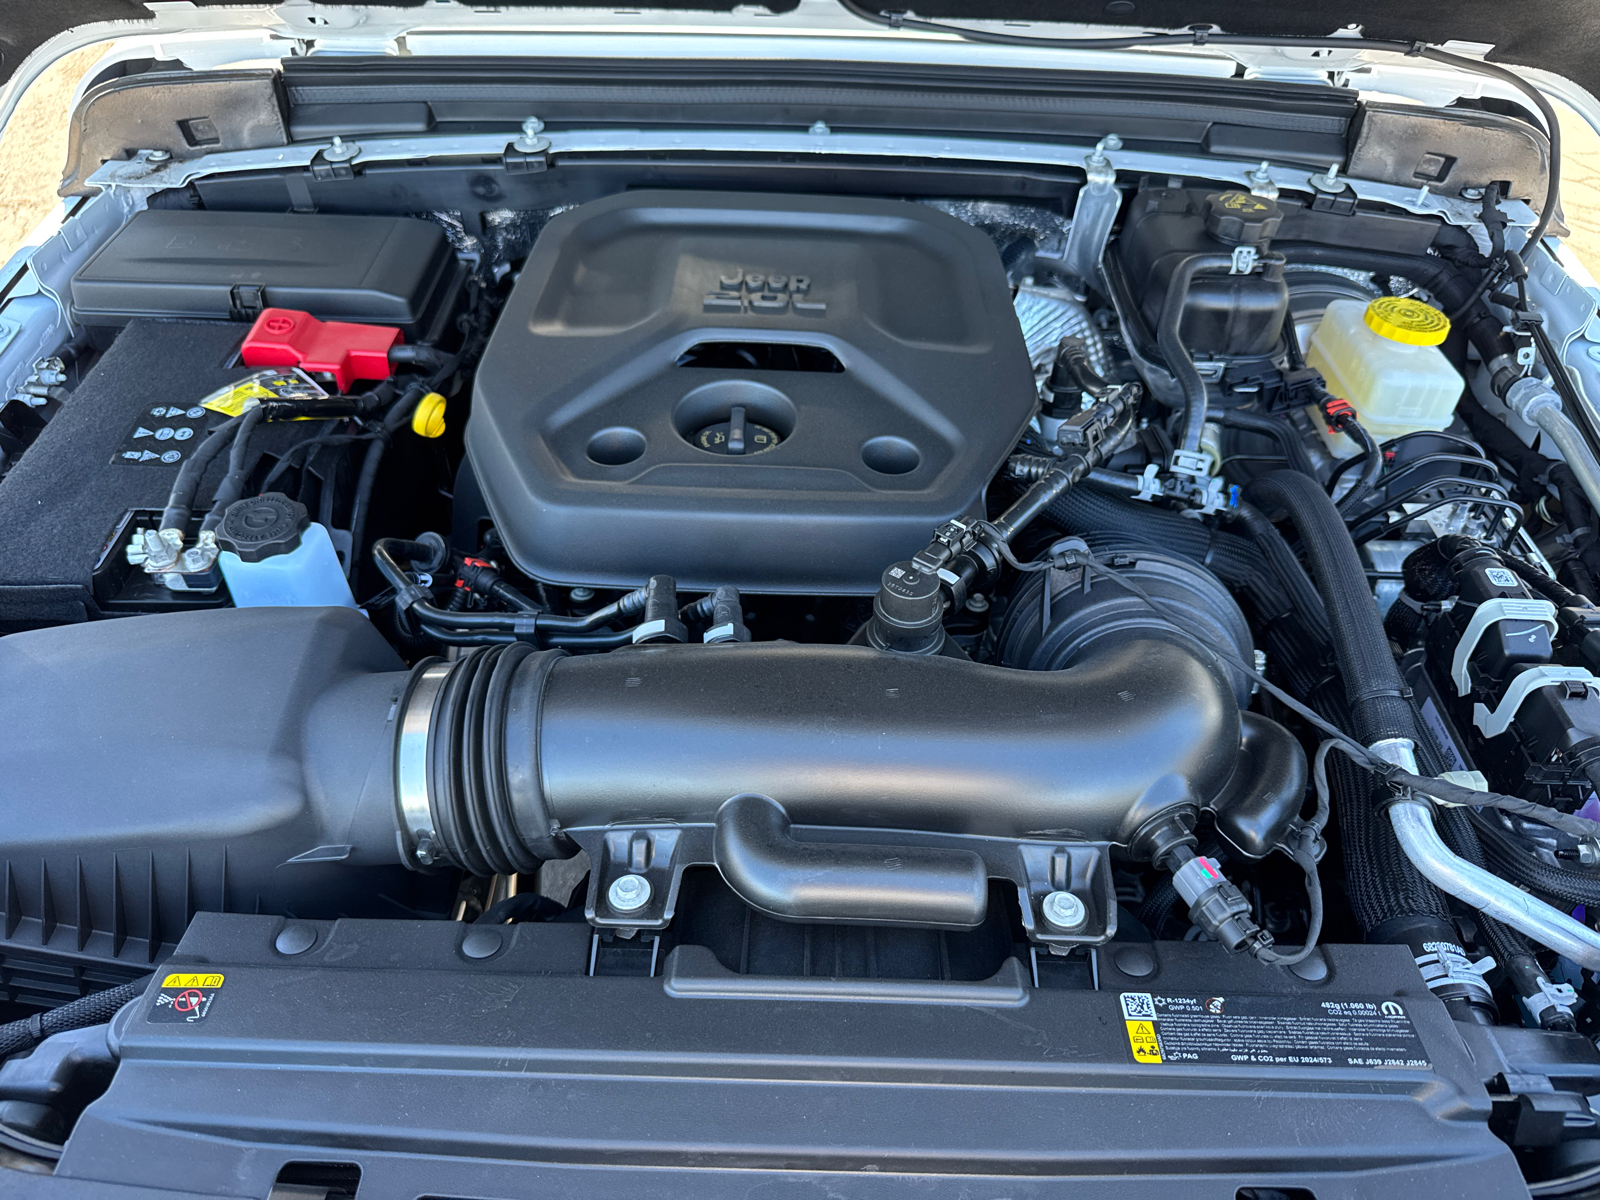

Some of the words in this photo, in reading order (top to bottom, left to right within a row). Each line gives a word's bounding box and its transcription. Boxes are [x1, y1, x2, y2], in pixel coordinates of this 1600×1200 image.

[719, 267, 812, 293] Jeep
[1230, 1054, 1249, 1062] GWP
[1275, 1056, 1287, 1064] per
[1347, 1057, 1364, 1065] SAE
